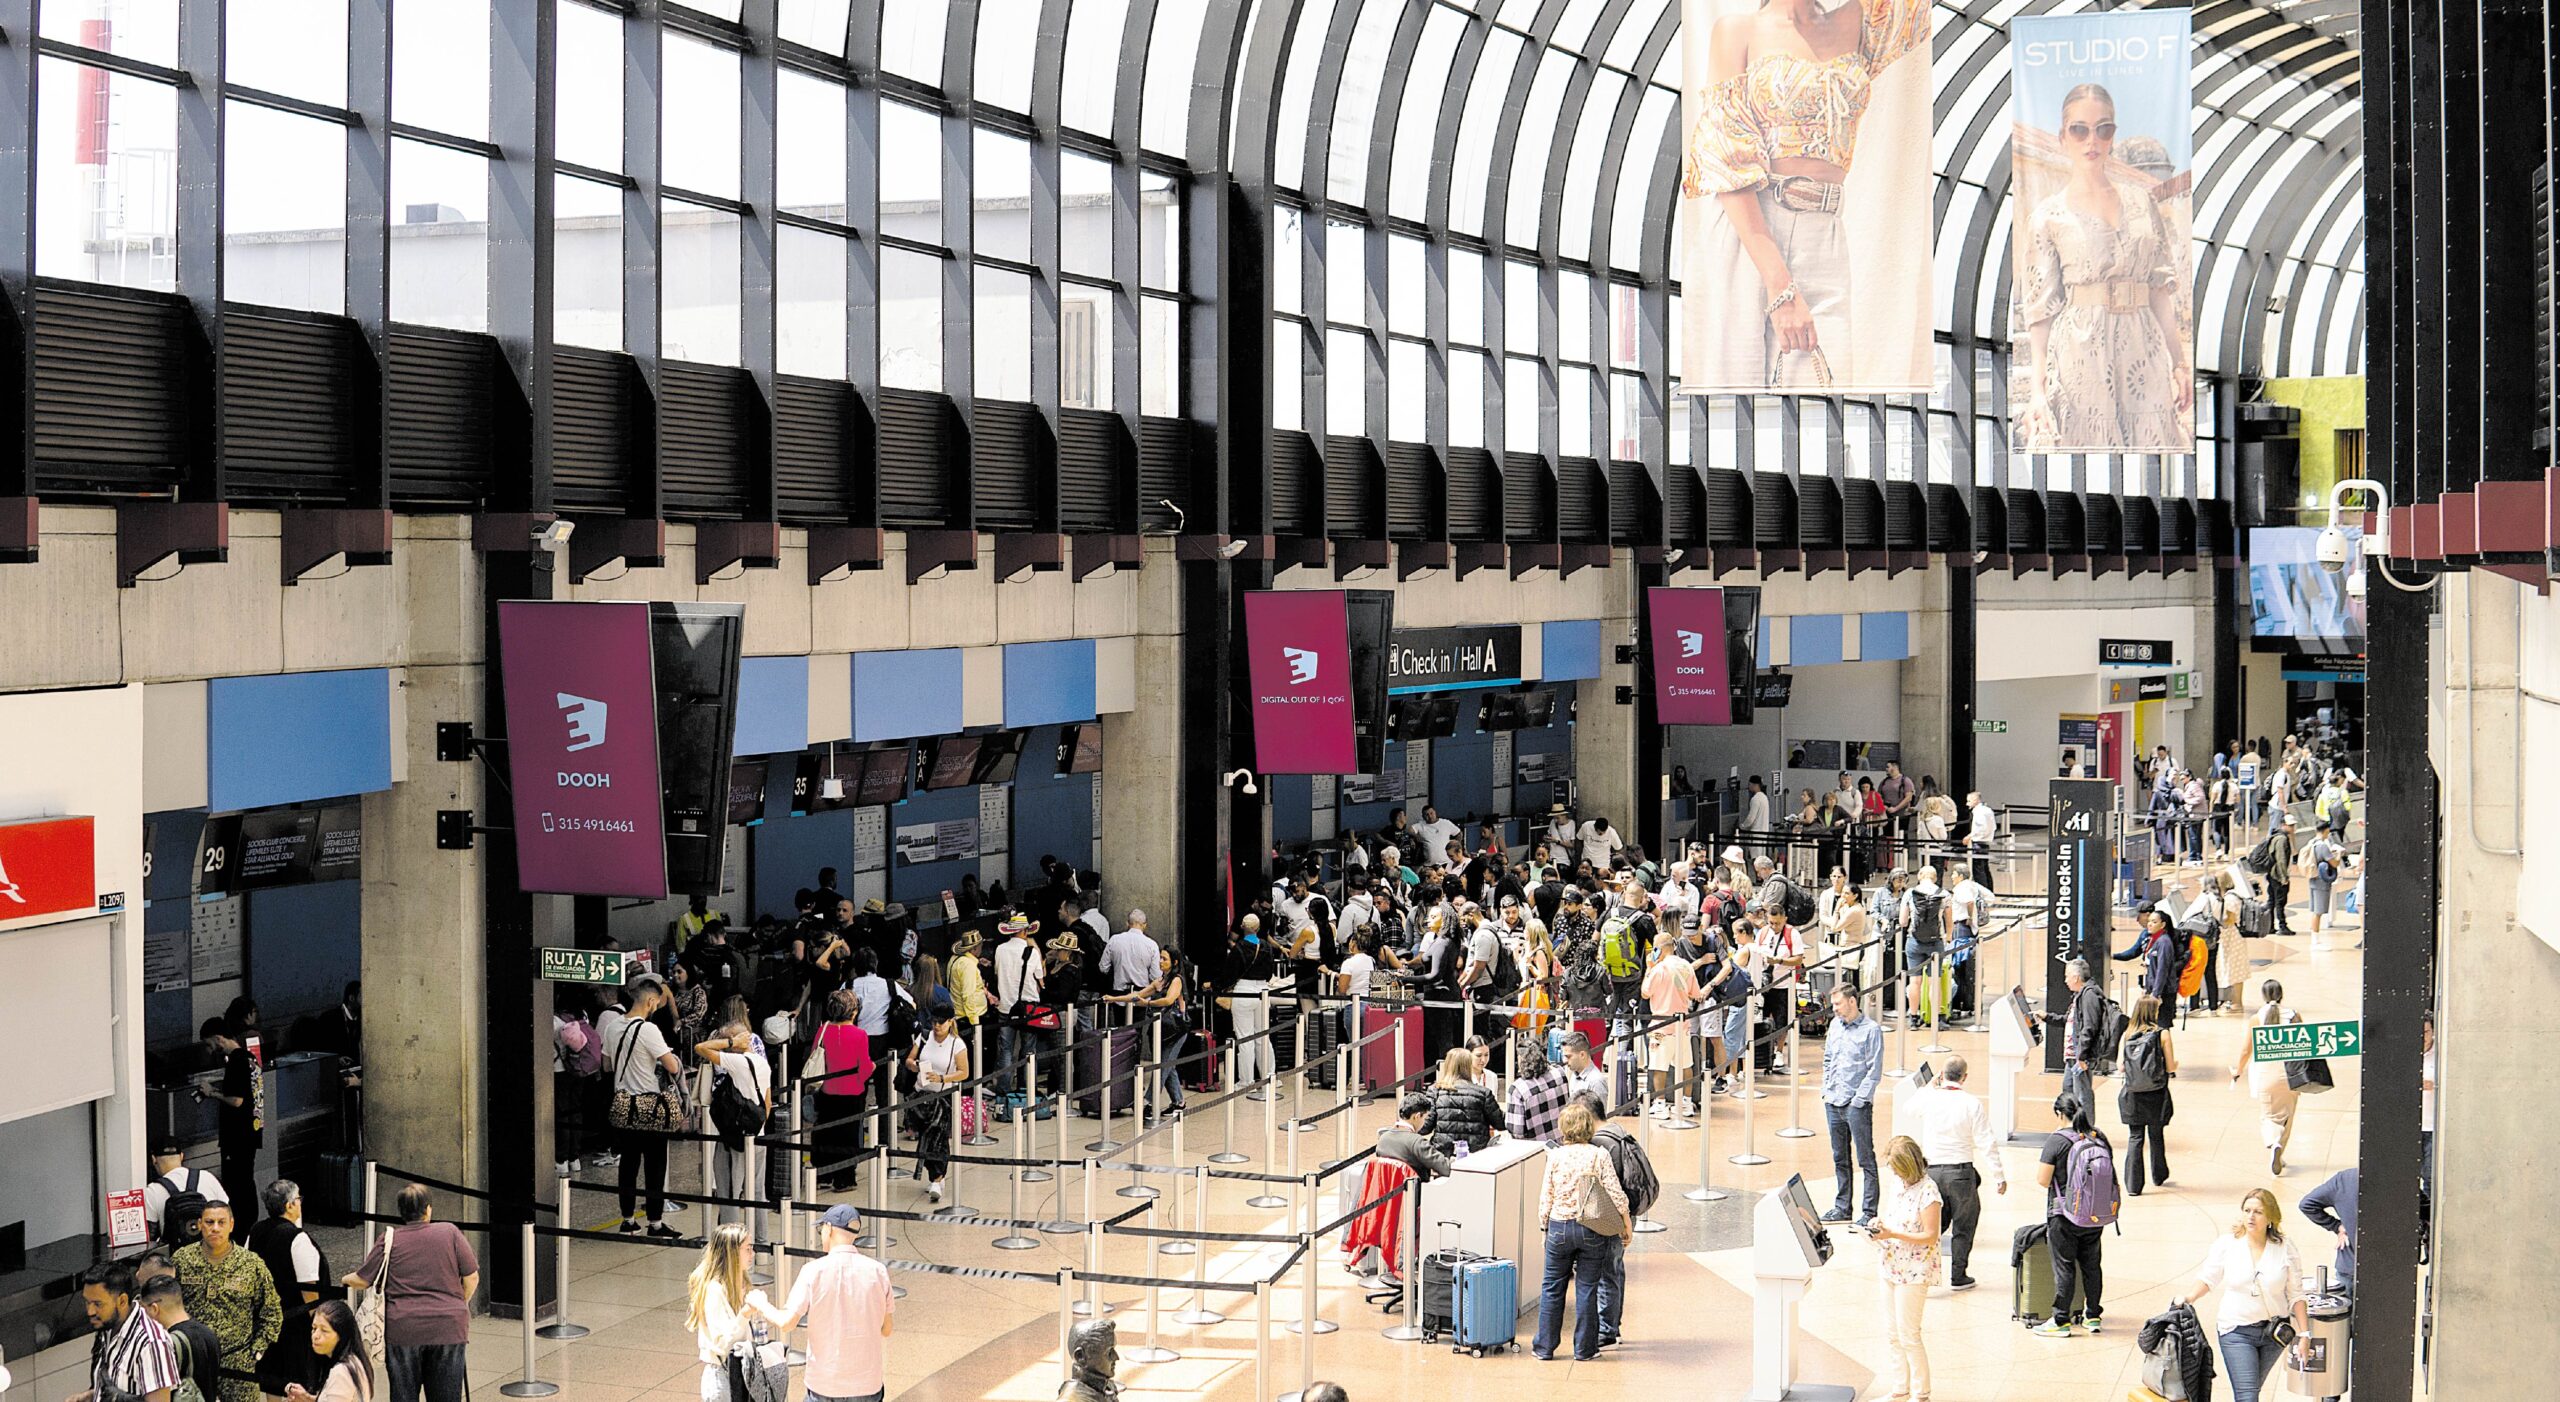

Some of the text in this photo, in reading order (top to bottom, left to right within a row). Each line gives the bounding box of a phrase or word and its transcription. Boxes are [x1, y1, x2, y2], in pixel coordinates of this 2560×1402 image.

[2024, 35, 2179, 66] STUDIO F
[2059, 64, 2144, 78] LIVE IN LINEN
[1401, 648, 1437, 675] Check
[1440, 649, 1450, 672] in
[1461, 645, 1481, 671] Hall
[1483, 638, 1497, 673] A
[1261, 696, 1289, 704] DIGITAL
[1762, 683, 1787, 701] jetBlue
[1388, 714, 1396, 727] 43
[1478, 707, 1487, 719] 45
[916, 749, 927, 766] 36
[1057, 744, 1068, 761] 37
[557, 771, 610, 788] DOOH
[916, 766, 924, 782] A
[794, 777, 807, 796] 35
[558, 817, 635, 833] 315 4916461
[204, 846, 225, 872] 29
[2055, 843, 2072, 964] Auto Check-In
[545, 951, 586, 967] RUTA
[2255, 1027, 2312, 1045] RUTA
[2267, 1042, 2312, 1051] EVACUACIÓN
[2257, 1052, 2293, 1060] EVACUATION
